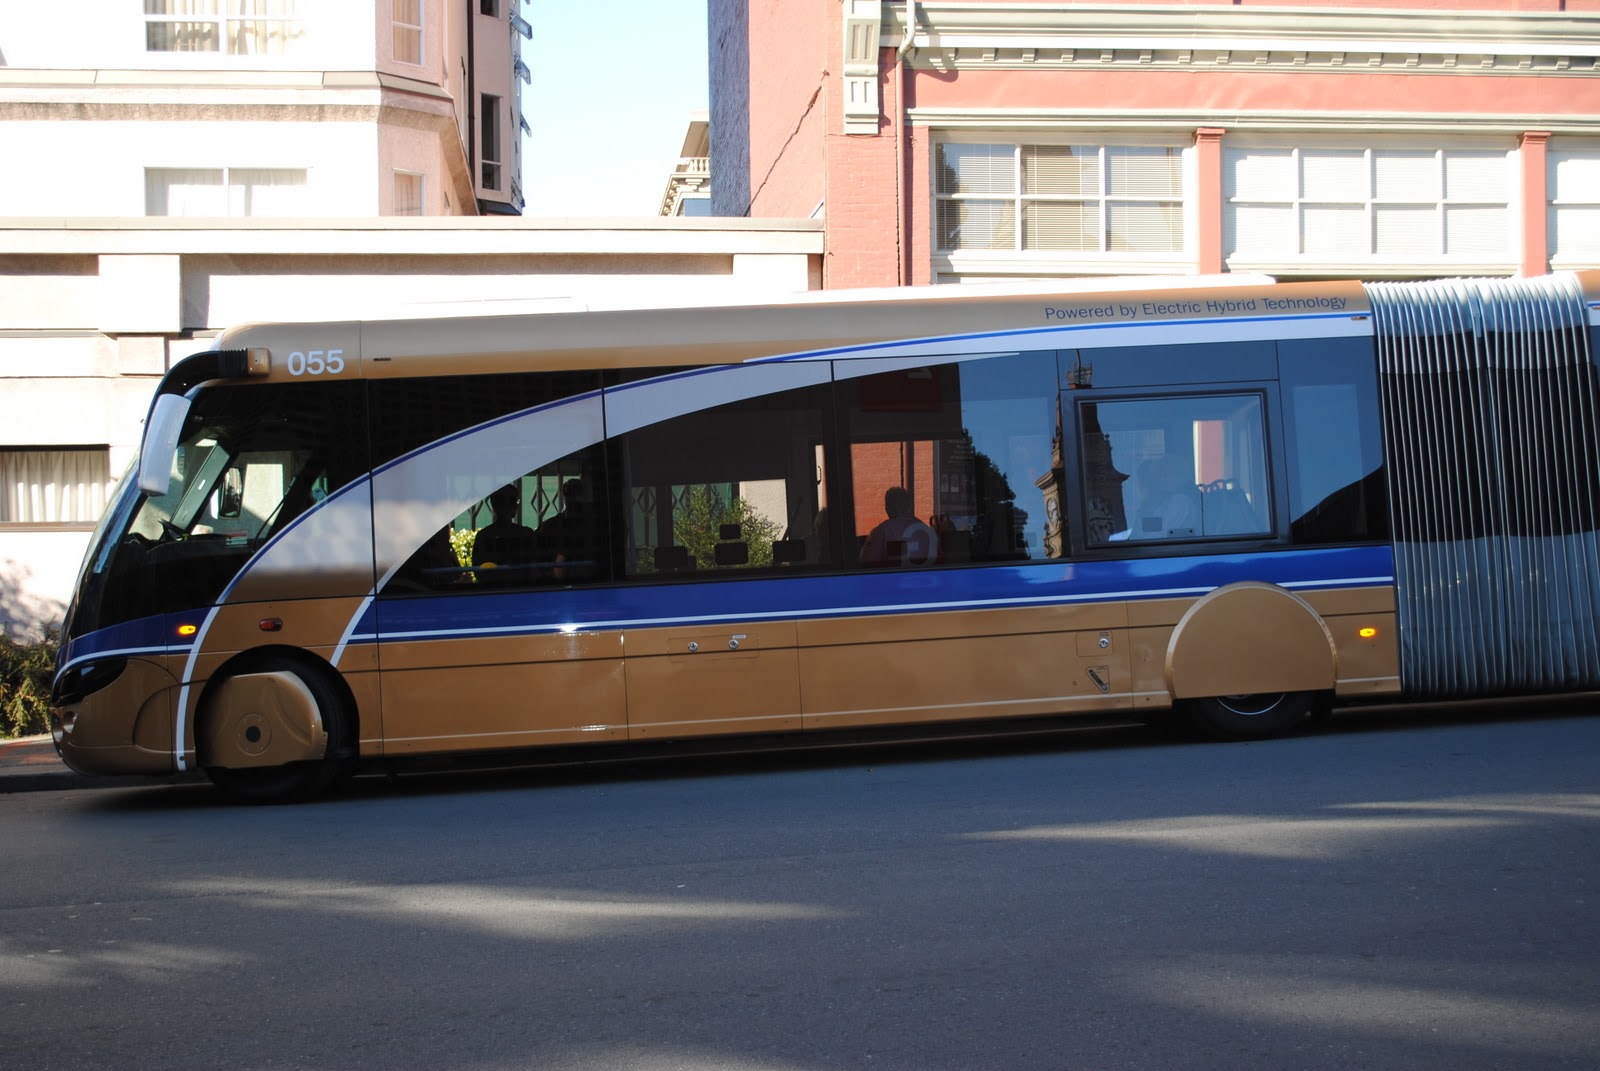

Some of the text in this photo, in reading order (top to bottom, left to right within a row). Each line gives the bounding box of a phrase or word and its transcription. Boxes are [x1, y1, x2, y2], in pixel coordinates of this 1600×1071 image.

[1045, 296, 1347, 320] Powered by Electric Hybrid Technology
[287, 349, 345, 376] 055
